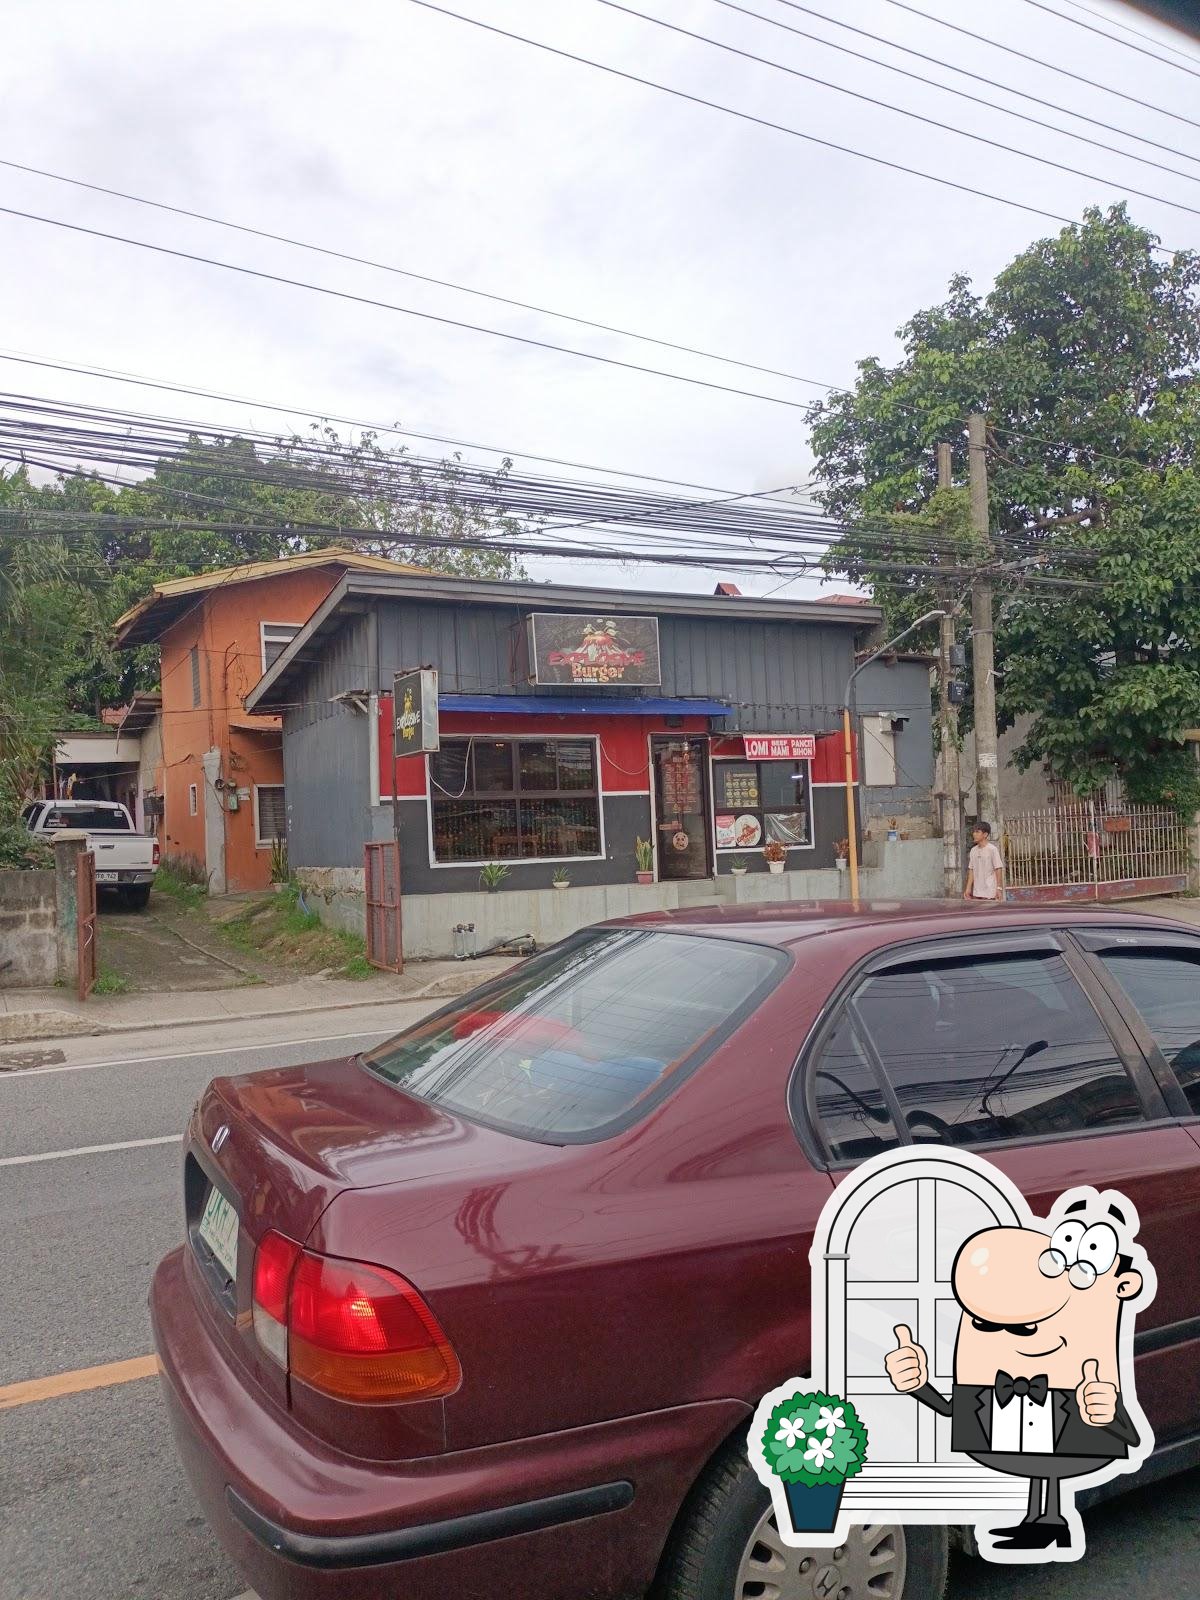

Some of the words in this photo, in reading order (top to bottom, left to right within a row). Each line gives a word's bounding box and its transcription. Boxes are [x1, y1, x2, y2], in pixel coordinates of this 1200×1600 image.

[571, 662, 624, 682] Burger
[745, 740, 769, 756] LOMI
[790, 740, 812, 748] PANCIT
[771, 746, 790, 756] MAMI
[792, 747, 813, 756] BIHON
